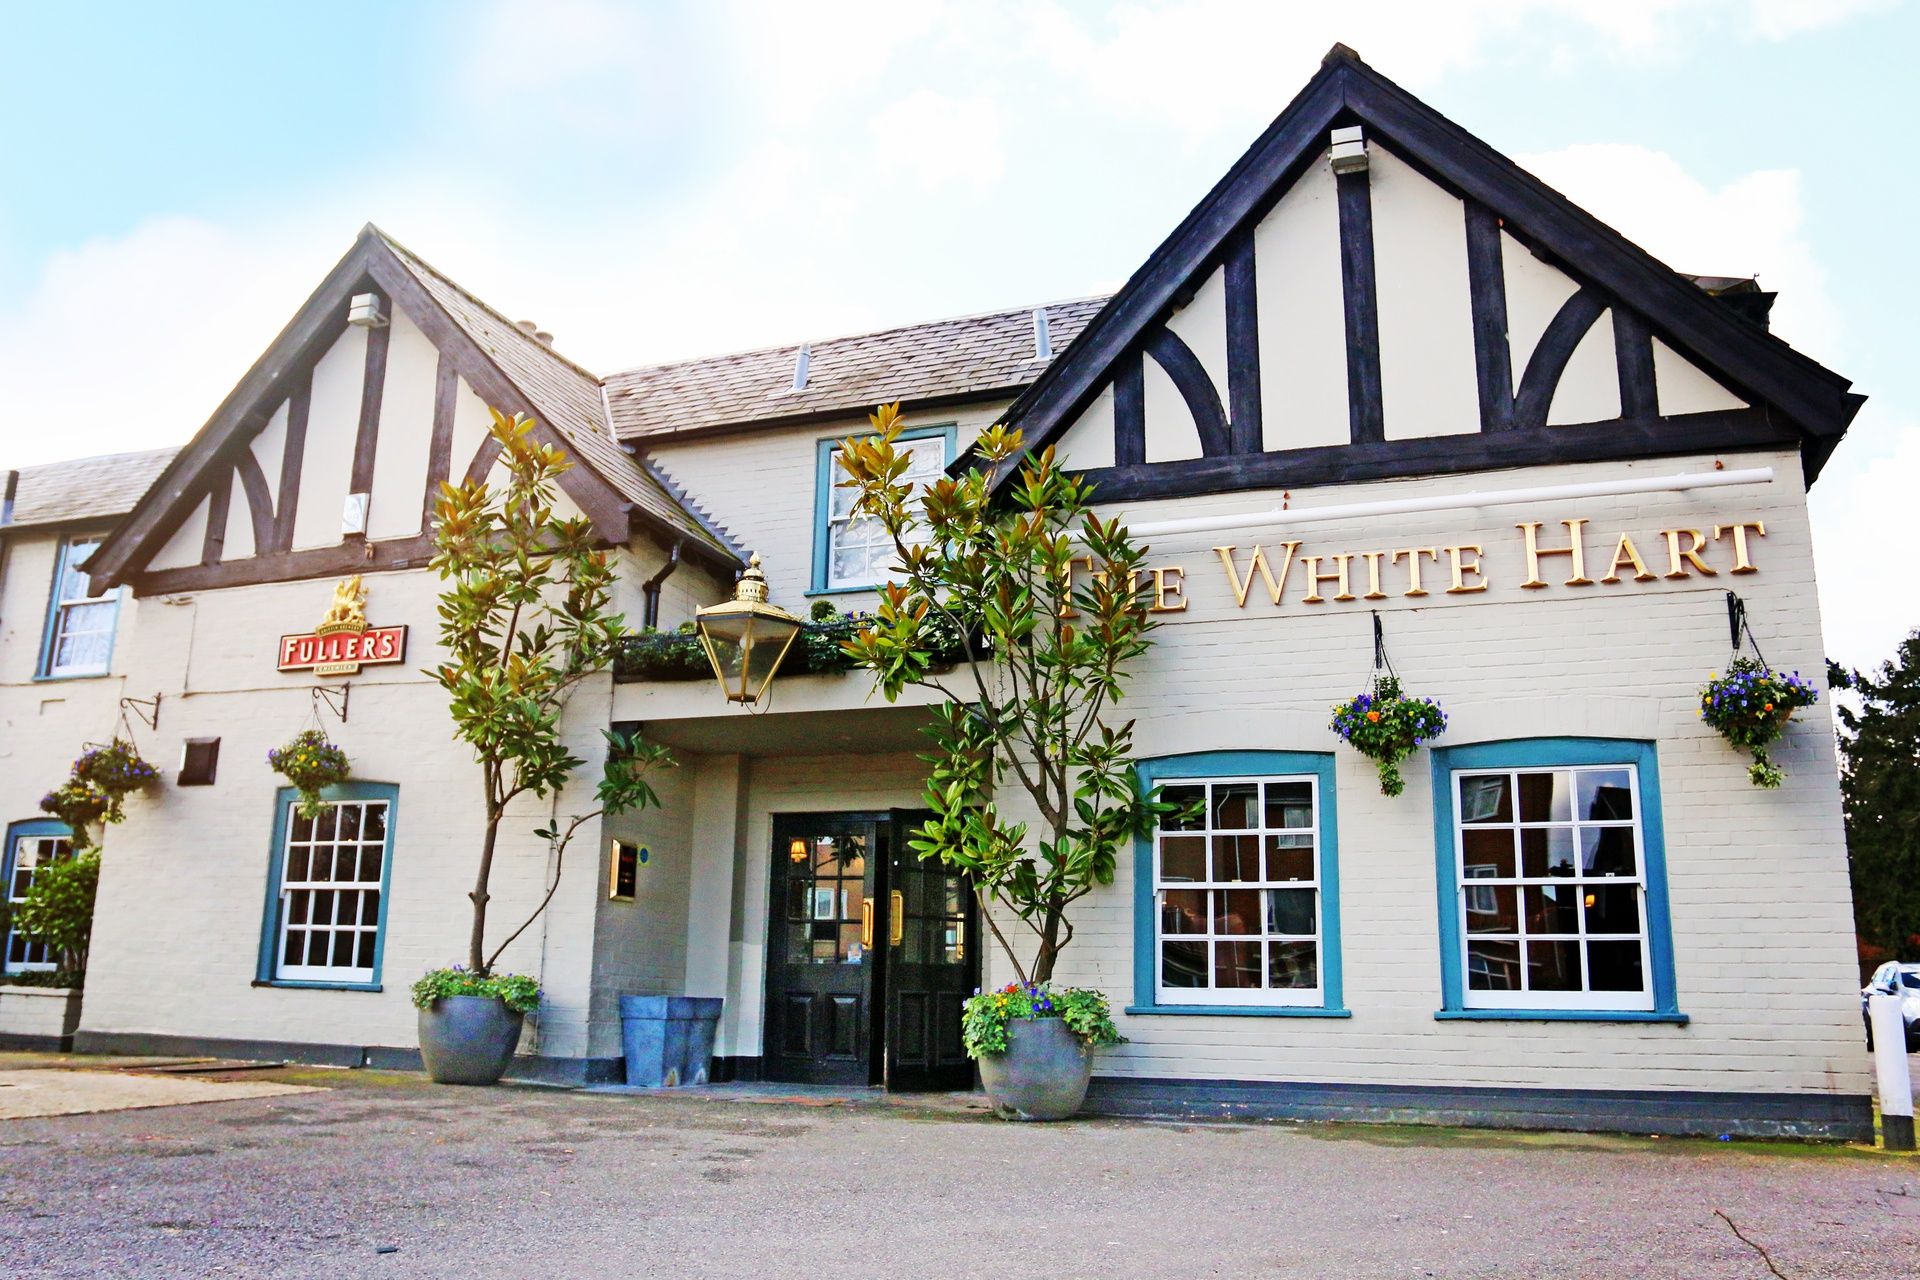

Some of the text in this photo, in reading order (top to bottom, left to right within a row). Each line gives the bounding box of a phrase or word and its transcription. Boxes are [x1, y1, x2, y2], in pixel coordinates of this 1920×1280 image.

[1212, 540, 1489, 608] WHITE
[1515, 518, 1766, 588] HART
[283, 632, 393, 663] FULLER'S
